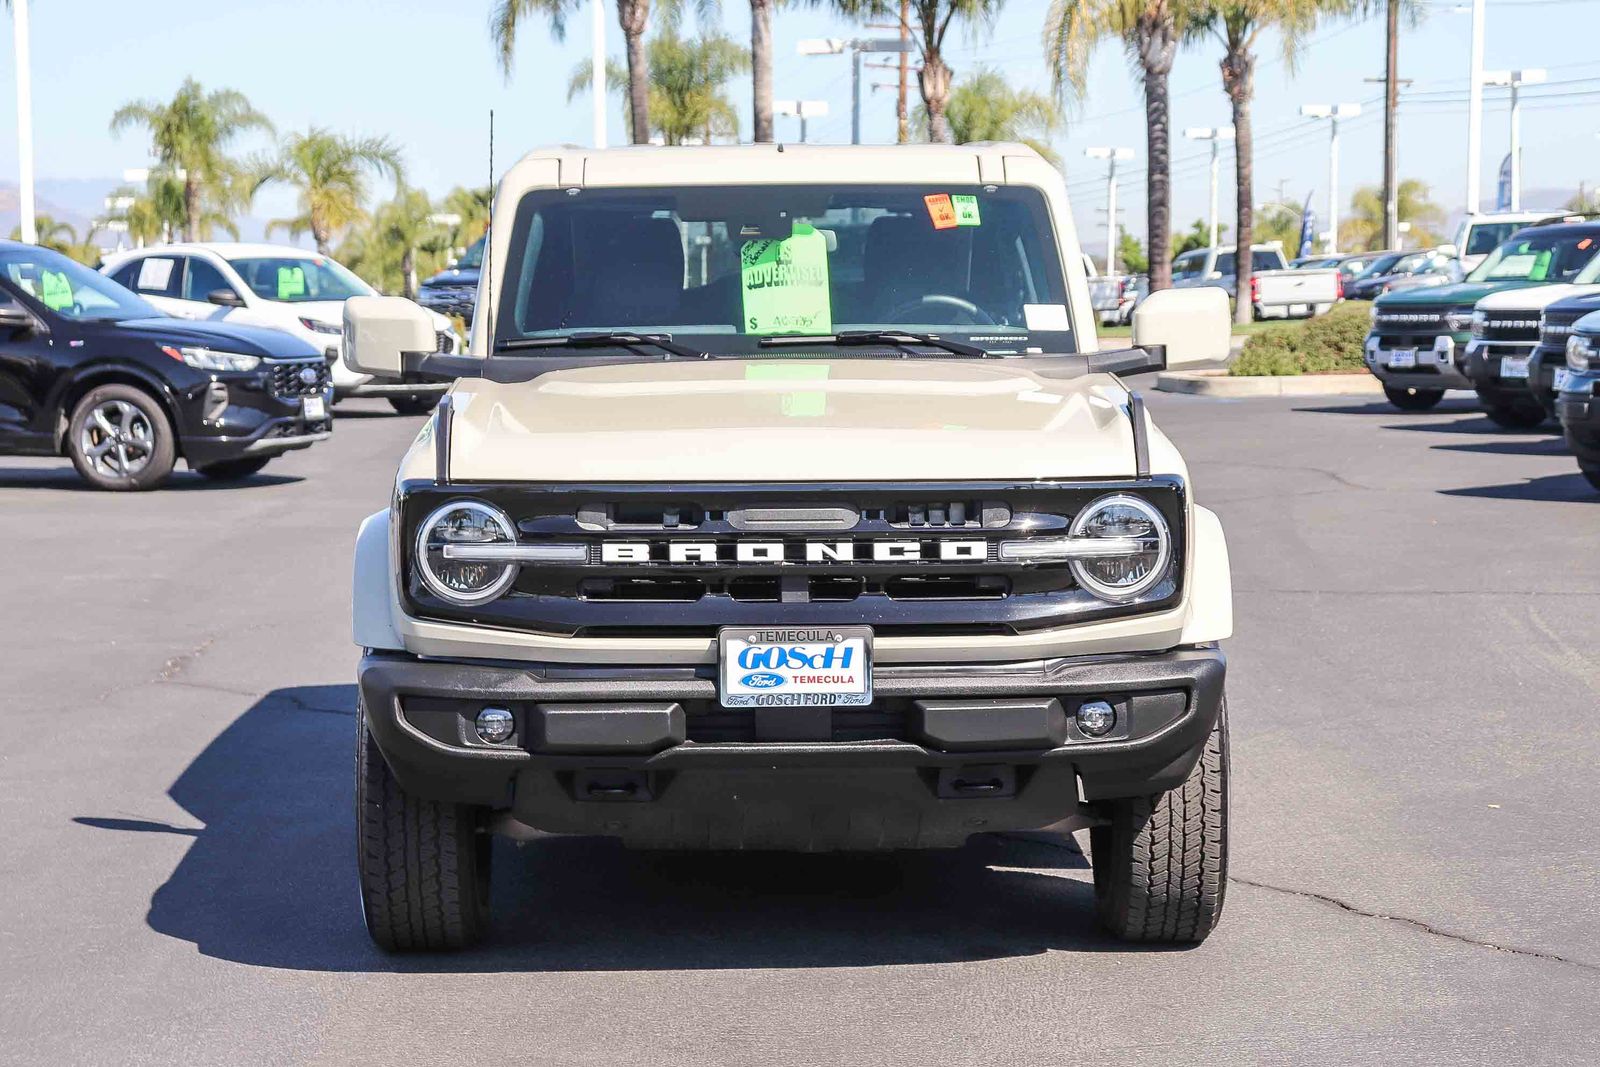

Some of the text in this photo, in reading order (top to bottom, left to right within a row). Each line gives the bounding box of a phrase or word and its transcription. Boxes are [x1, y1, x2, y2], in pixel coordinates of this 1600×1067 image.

[602, 542, 988, 562] BRONCO
[756, 630, 835, 643] TEMECULA
[748, 674, 855, 687] Ford TEMECULA
